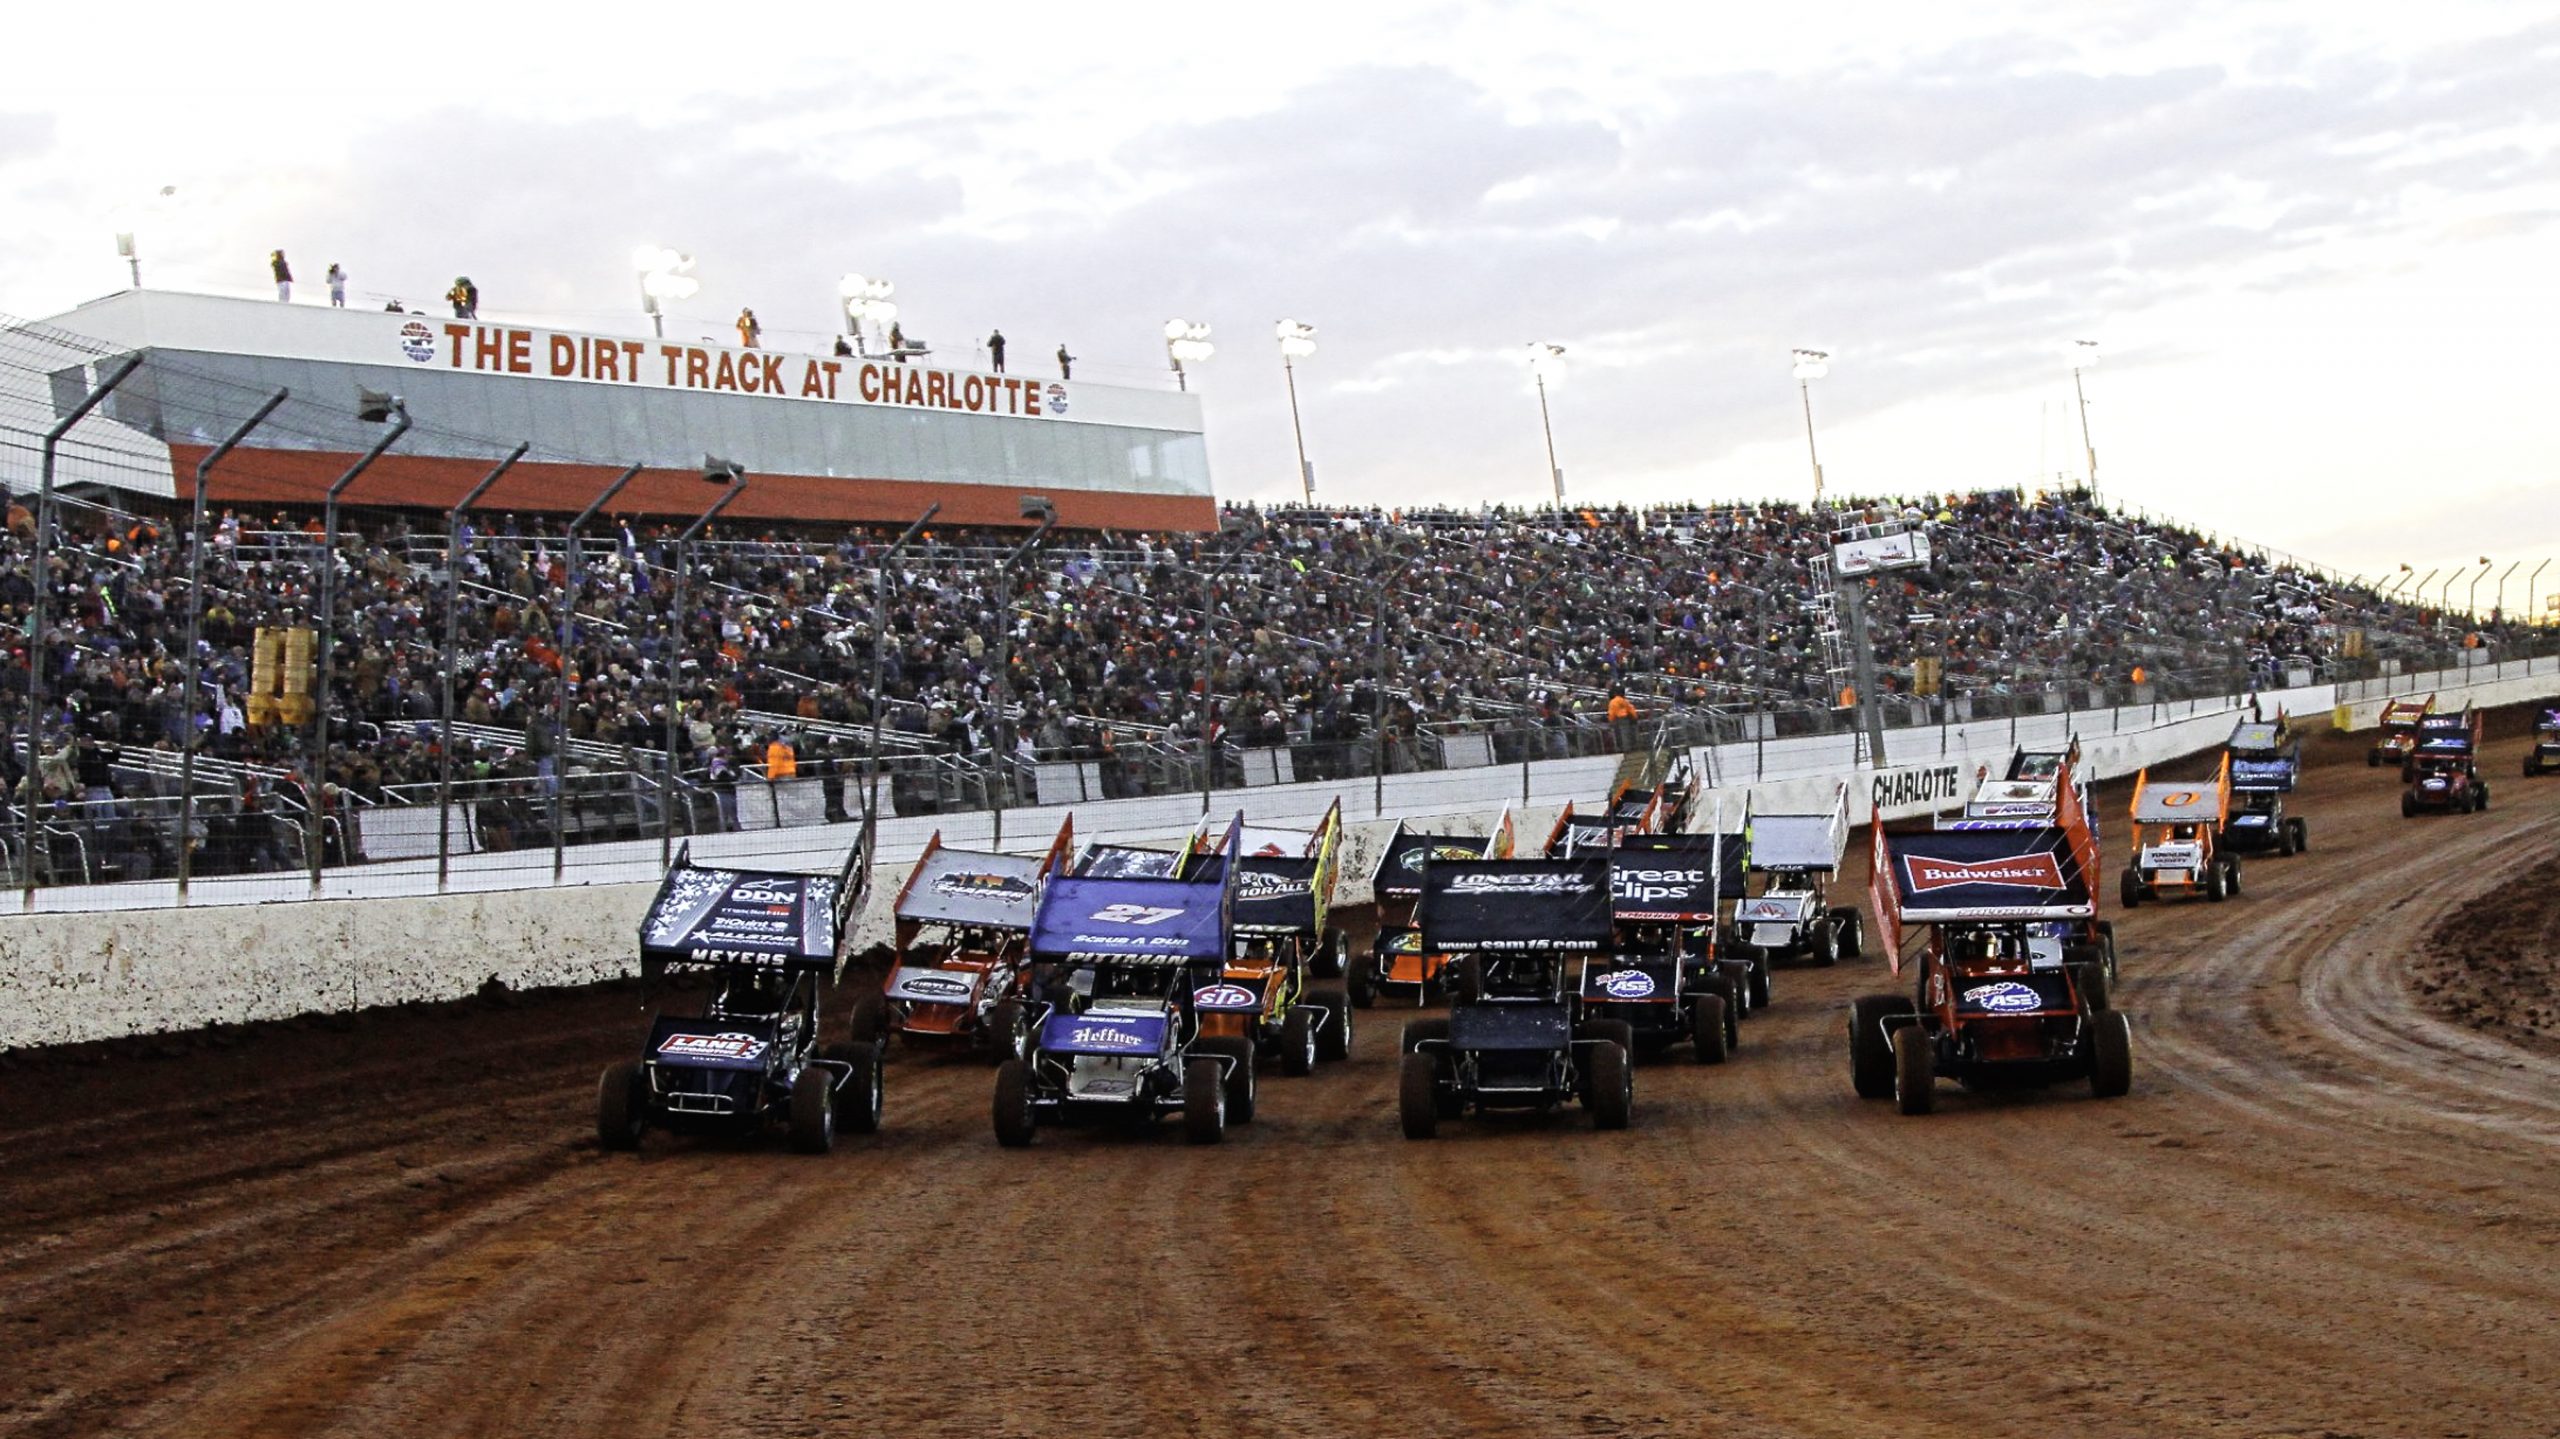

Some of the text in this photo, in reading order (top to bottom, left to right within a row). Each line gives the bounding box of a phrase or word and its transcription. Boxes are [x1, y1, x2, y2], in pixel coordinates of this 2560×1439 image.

[444, 323, 532, 374] THE
[550, 333, 645, 383] DIRT
[661, 345, 786, 395] TRACK
[801, 359, 842, 400] AT
[859, 363, 1042, 416] CHARLOTTE
[1872, 765, 1959, 809] CHARLOTTE
[1452, 873, 1584, 885] LONESTAR
[1922, 867, 2047, 881] Budweiser
[731, 889, 798, 903] DDN
[1089, 903, 1185, 925] 27
[714, 916, 769, 928] TriQuint
[1131, 937, 1146, 945] A
[691, 948, 788, 966] MEYERS
[1065, 951, 1190, 966] PITTMAN
[1612, 980, 1649, 991] ASE
[1198, 988, 1246, 1005] STP
[1989, 994, 2034, 1007] ASE
[672, 1037, 747, 1050] LANE
[1071, 1027, 1144, 1046] Heffner
